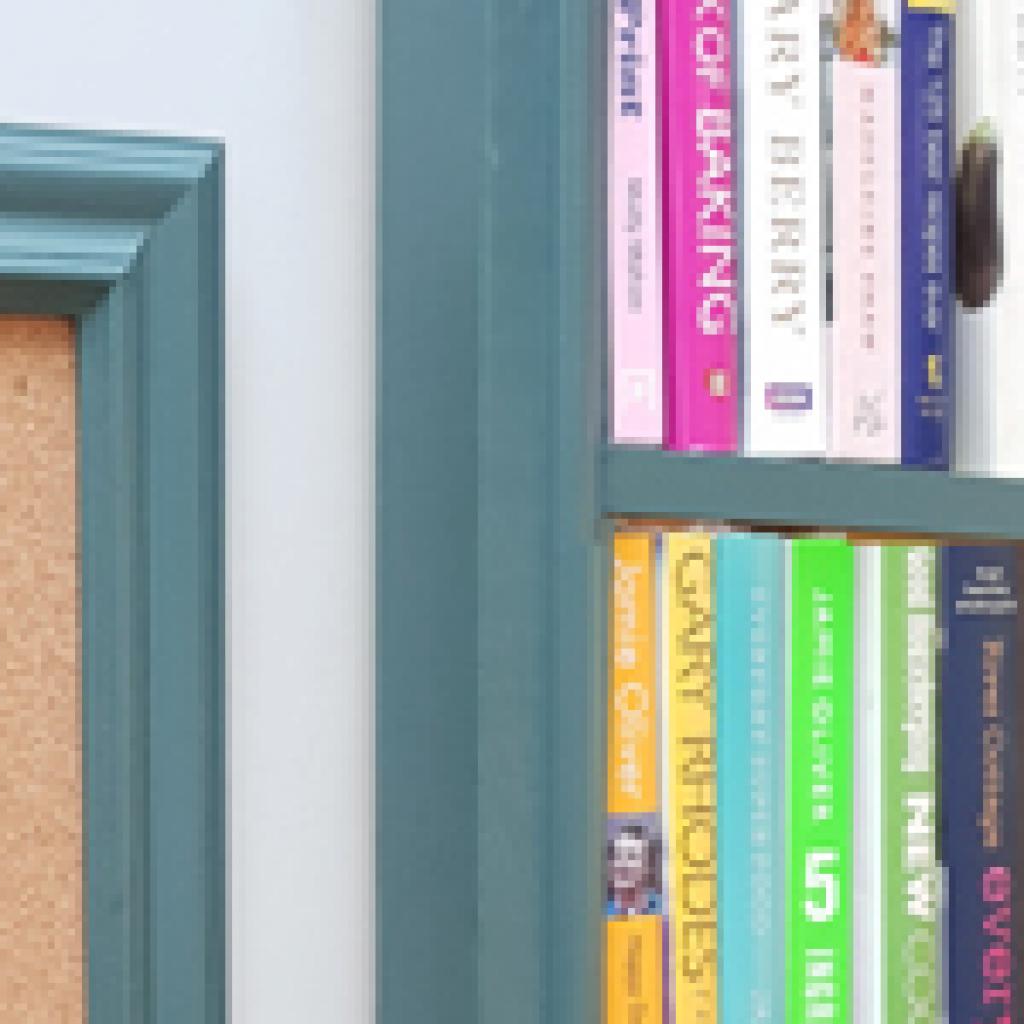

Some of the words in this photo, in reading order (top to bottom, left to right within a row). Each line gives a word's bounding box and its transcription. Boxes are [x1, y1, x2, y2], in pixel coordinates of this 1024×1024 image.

[694, 26, 727, 88] OF
[695, 108, 736, 335] BAKING
[770, 136, 806, 336] BERRY
[613, 556, 641, 668] Jamie
[677, 549, 713, 711] GARY
[812, 587, 832, 687] JAMIE
[615, 681, 648, 799] Oliver
[981, 639, 1004, 718] River
[812, 697, 832, 821] OLIVER
[978, 725, 1004, 849] Cottage
[680, 735, 717, 982] RHODES
[803, 849, 839, 923] 5
[904, 791, 936, 919] NEW
